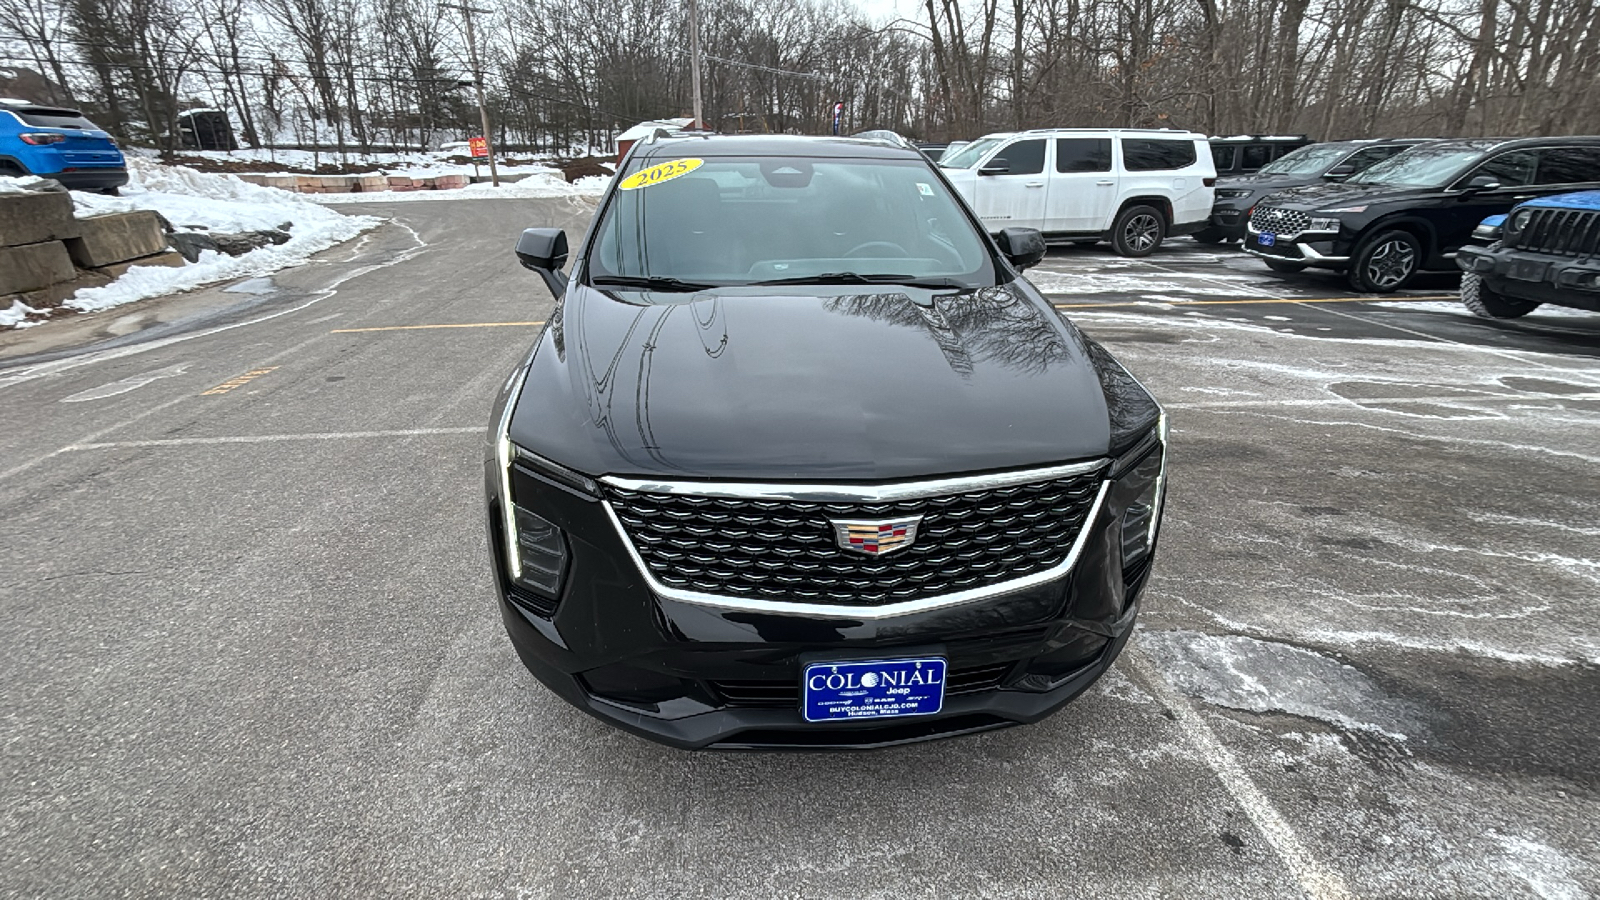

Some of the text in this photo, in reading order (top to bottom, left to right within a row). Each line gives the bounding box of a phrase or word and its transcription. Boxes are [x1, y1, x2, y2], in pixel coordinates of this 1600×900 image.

[636, 160, 688, 187] 2025
[809, 669, 941, 691] COLONIAL
[886, 687, 911, 696] Jeep
